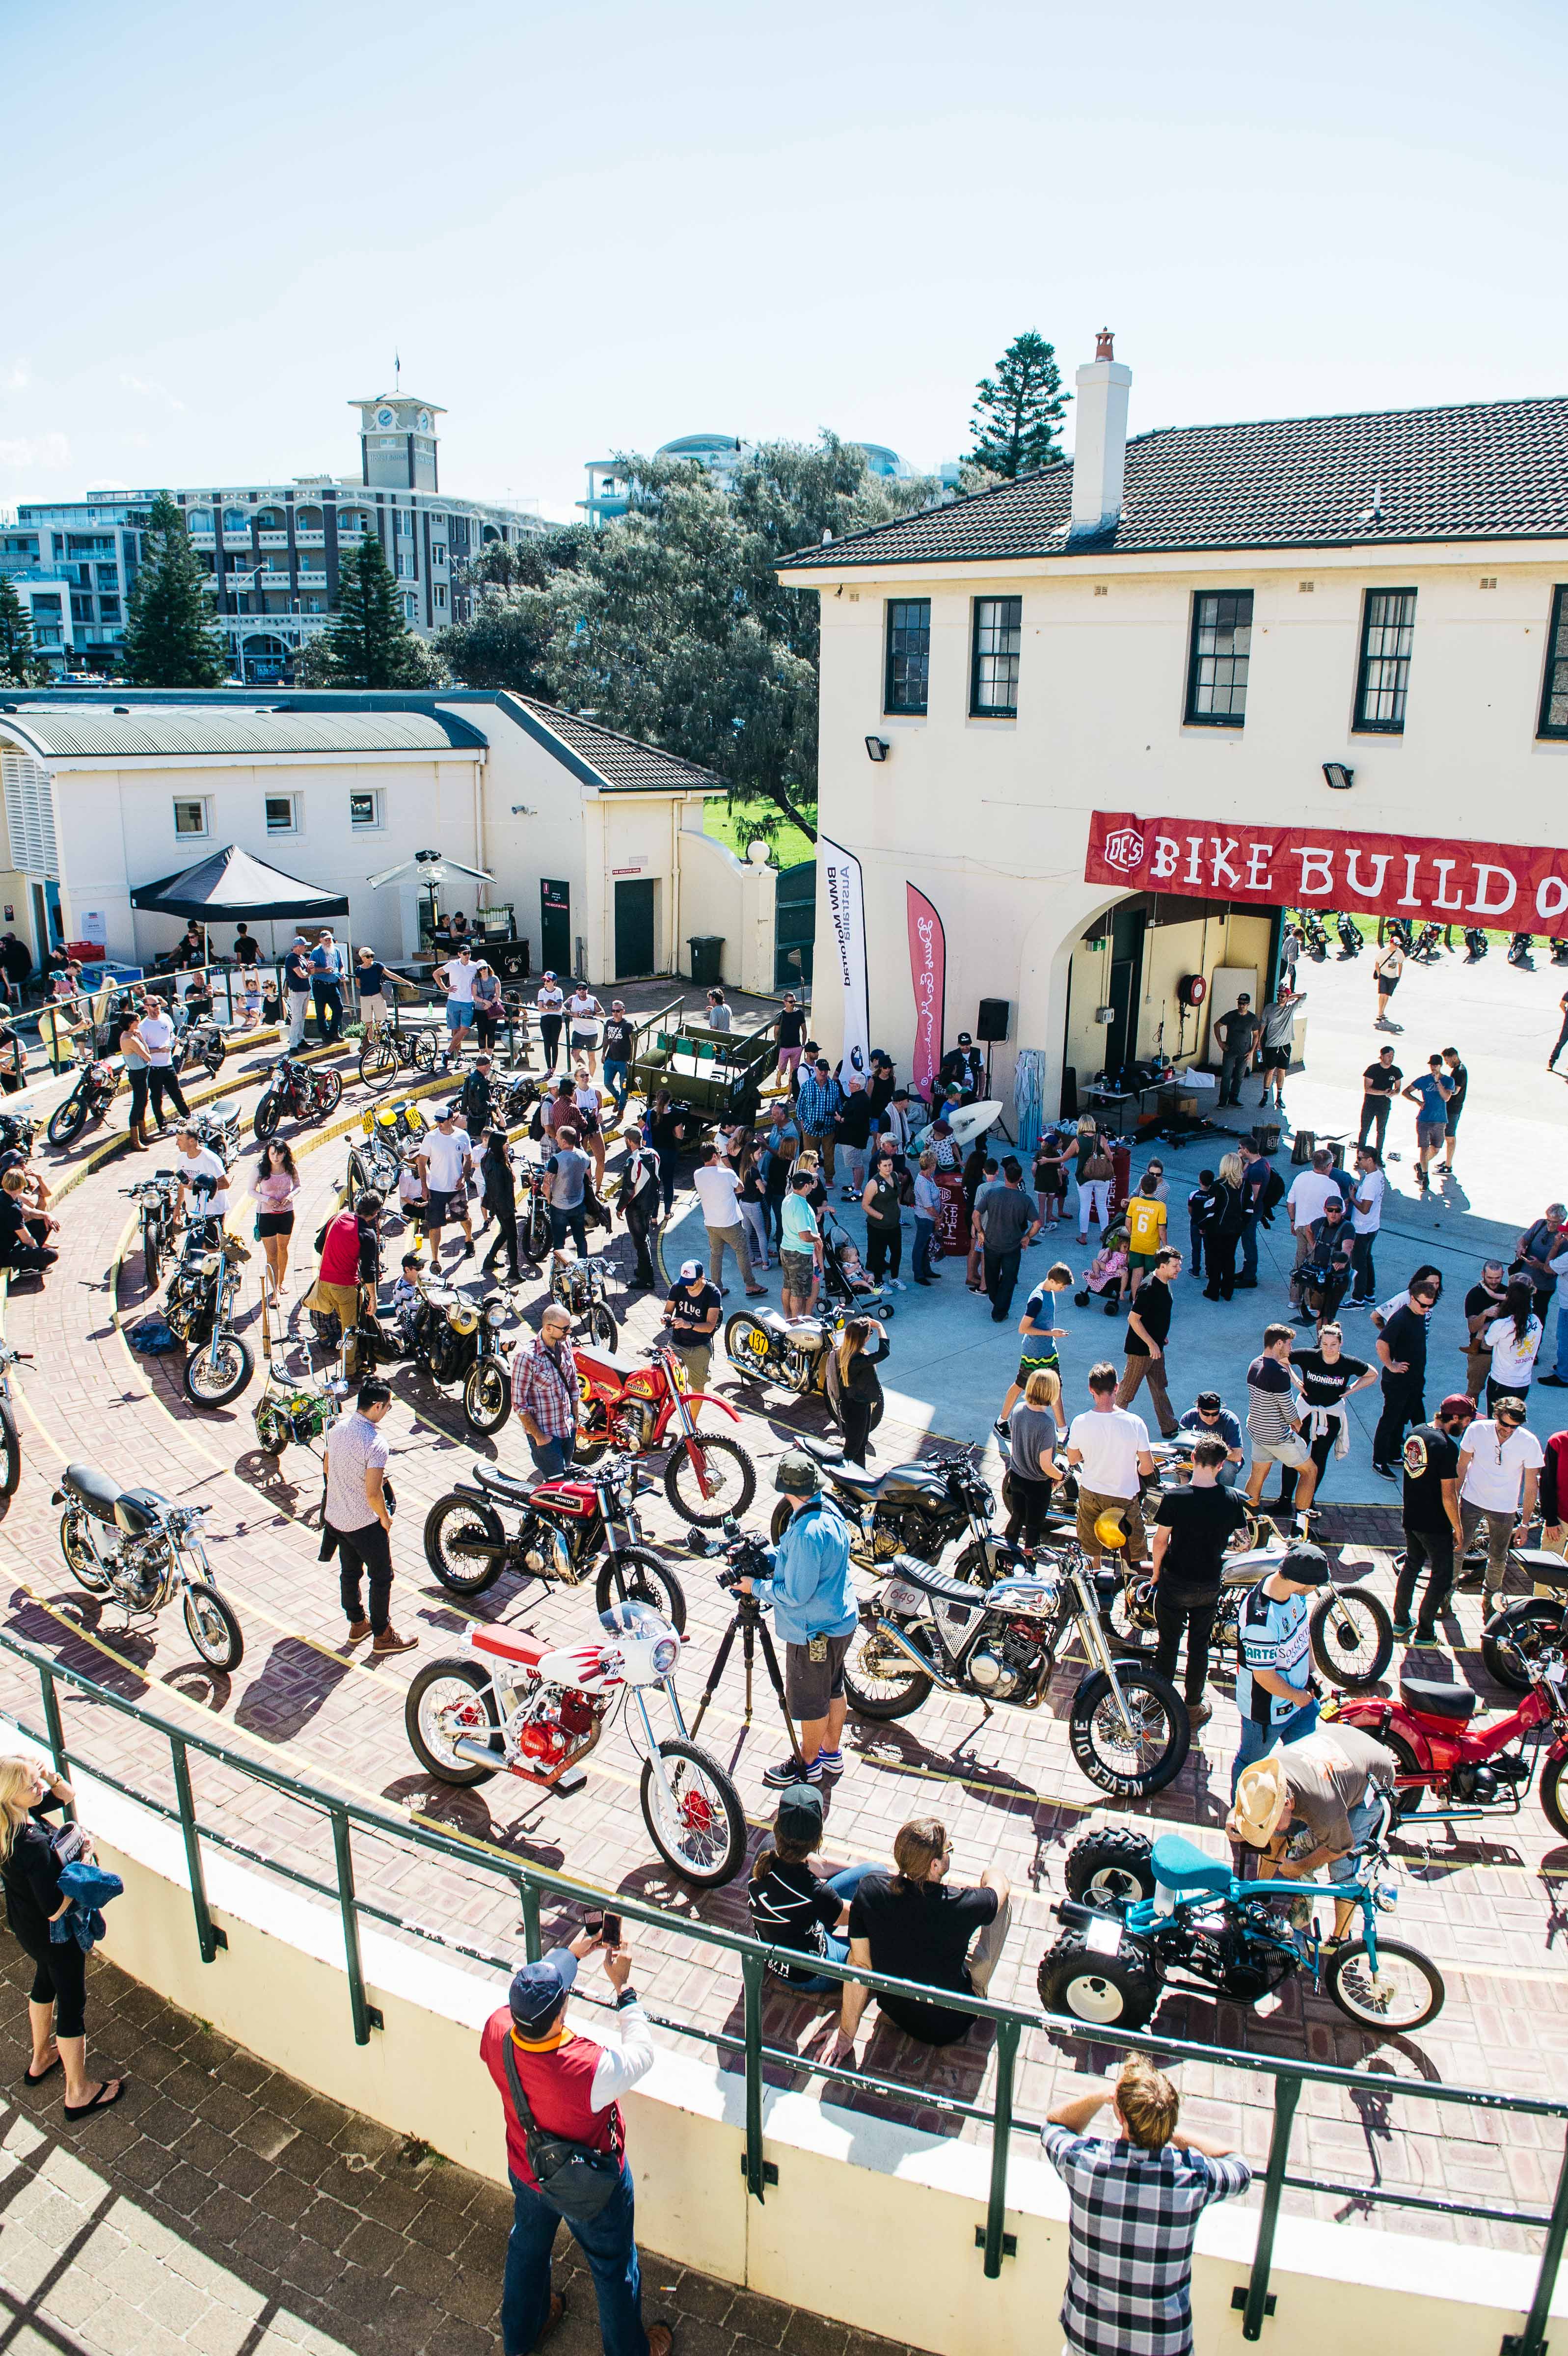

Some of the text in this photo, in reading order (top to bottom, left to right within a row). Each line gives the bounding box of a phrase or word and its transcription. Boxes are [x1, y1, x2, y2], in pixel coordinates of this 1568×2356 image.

[388, 452, 407, 461] Bondi
[1109, 835, 1142, 865] DES
[1150, 836, 1273, 890] BIKE
[1291, 847, 1517, 914] BUILD
[1137, 1214, 1149, 1233] 6
[752, 1331, 766, 1353] 137
[555, 1496, 575, 1505] HONDA
[891, 1589, 915, 1604] 649
[525, 1739, 540, 1750] YAMAHA
[1074, 1720, 1143, 1797] NEVER DIE
